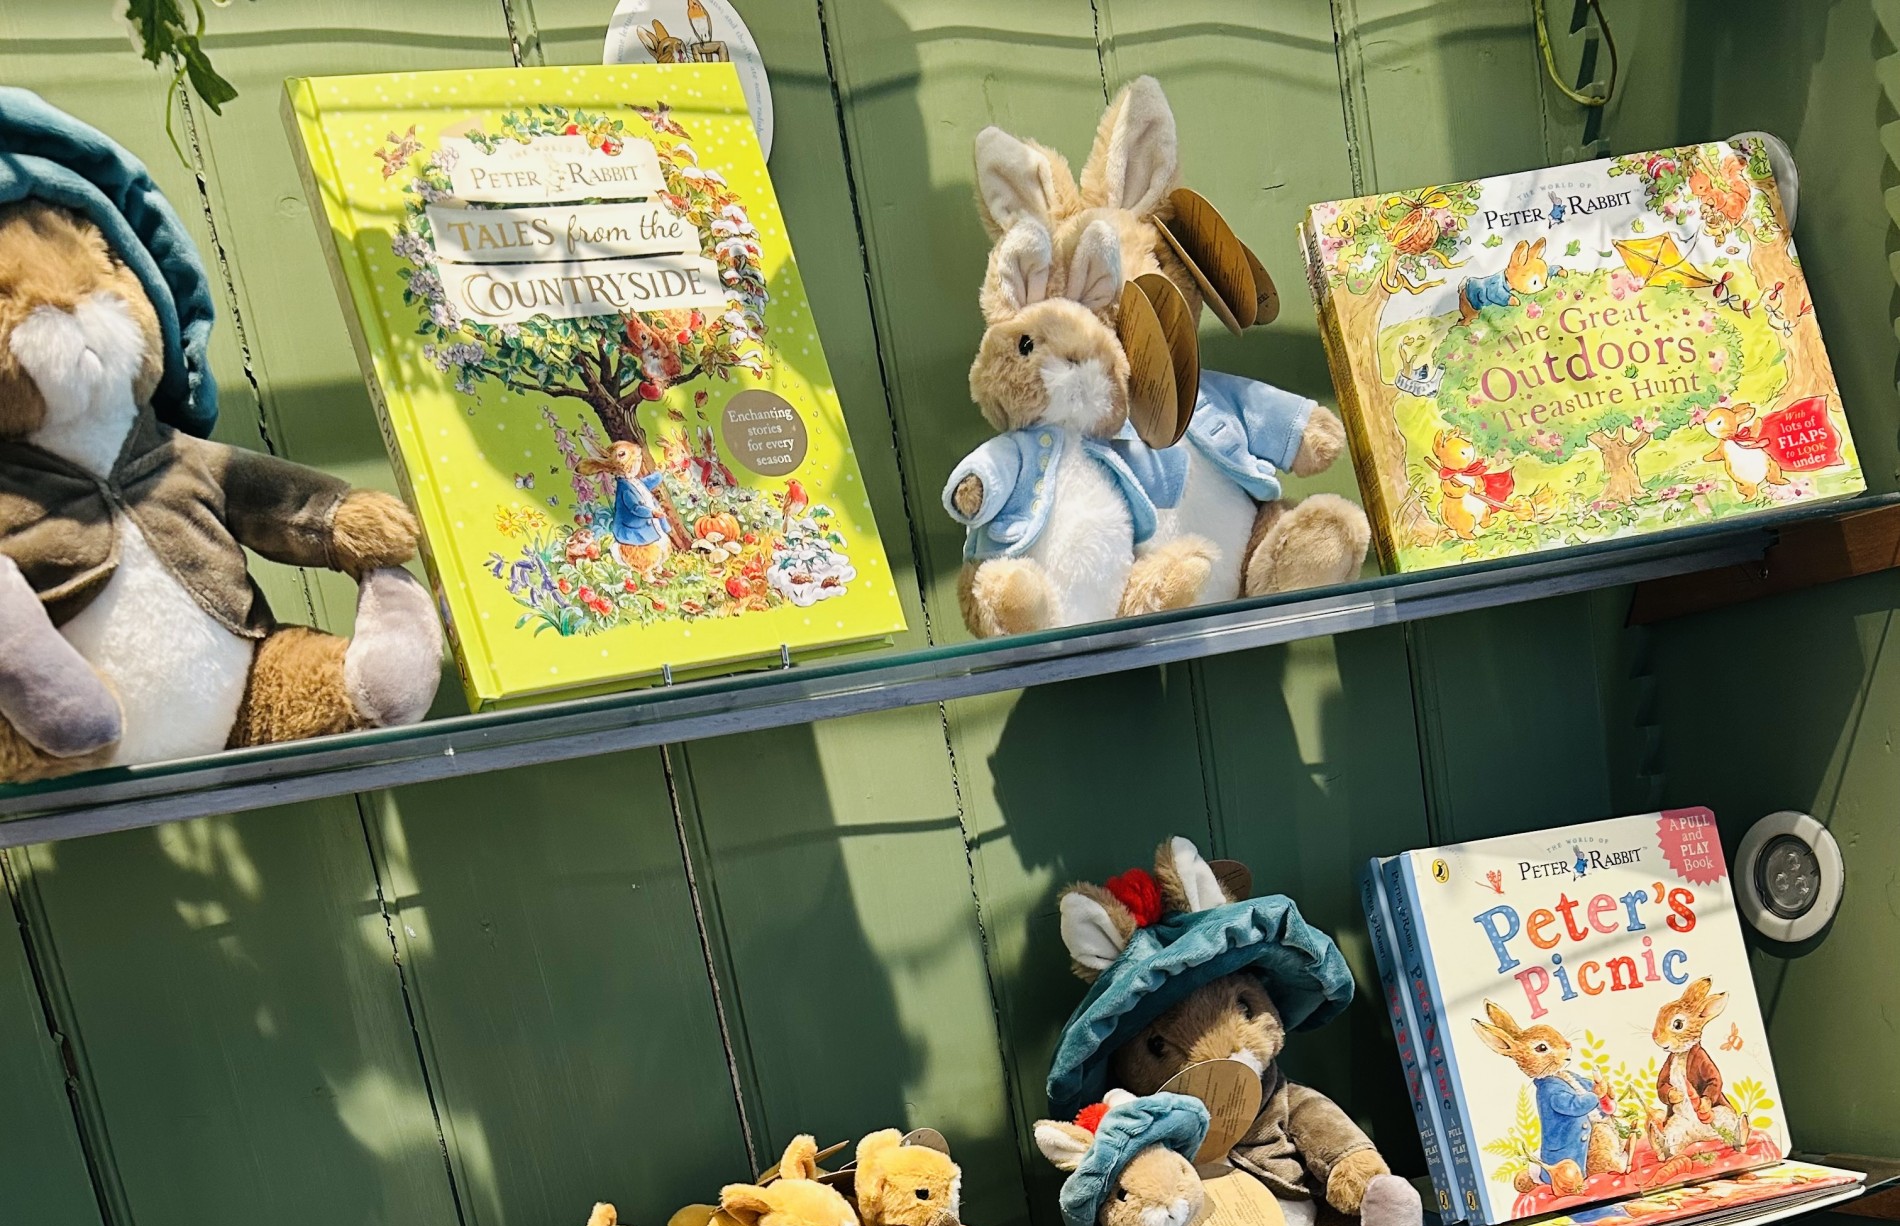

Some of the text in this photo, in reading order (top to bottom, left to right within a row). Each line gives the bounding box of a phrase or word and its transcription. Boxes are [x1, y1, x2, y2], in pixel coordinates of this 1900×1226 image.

[470, 161, 640, 190] PETER RABBIT
[1516, 189, 1534, 201] THE
[1539, 182, 1574, 191] WORLD
[1483, 190, 1632, 230] PETER RABBIT
[447, 209, 684, 255] TALES from the
[461, 266, 707, 318] COUNTRYSIDE
[1497, 299, 1651, 354] The Great
[1480, 334, 1698, 404] Outdoors
[1492, 371, 1702, 434] Treasure Hunt
[727, 406, 794, 423] Enchanting
[1784, 409, 1806, 421] With
[747, 422, 783, 437] stories
[1780, 415, 1816, 434] lots of
[747, 438, 795, 452] for every
[1777, 427, 1828, 450] FLAPS
[1785, 442, 1829, 459] to LOOK
[756, 453, 793, 467] season
[1792, 453, 1827, 469] under
[1669, 814, 1711, 832] A PULL
[1546, 842, 1562, 853] THE
[1565, 836, 1594, 846] WORLD
[1681, 829, 1704, 843] and
[1679, 840, 1711, 858] PLAY
[1518, 848, 1642, 881] PETER RABBIT
[1683, 856, 1715, 873] Book
[1473, 880, 1698, 976] Peter's
[1514, 935, 1690, 1021] Picnic
[1420, 1127, 1435, 1140] PULL
[1447, 1127, 1463, 1139] PULL
[1424, 1144, 1439, 1158] PLAY
[1451, 1143, 1467, 1156] PLAY
